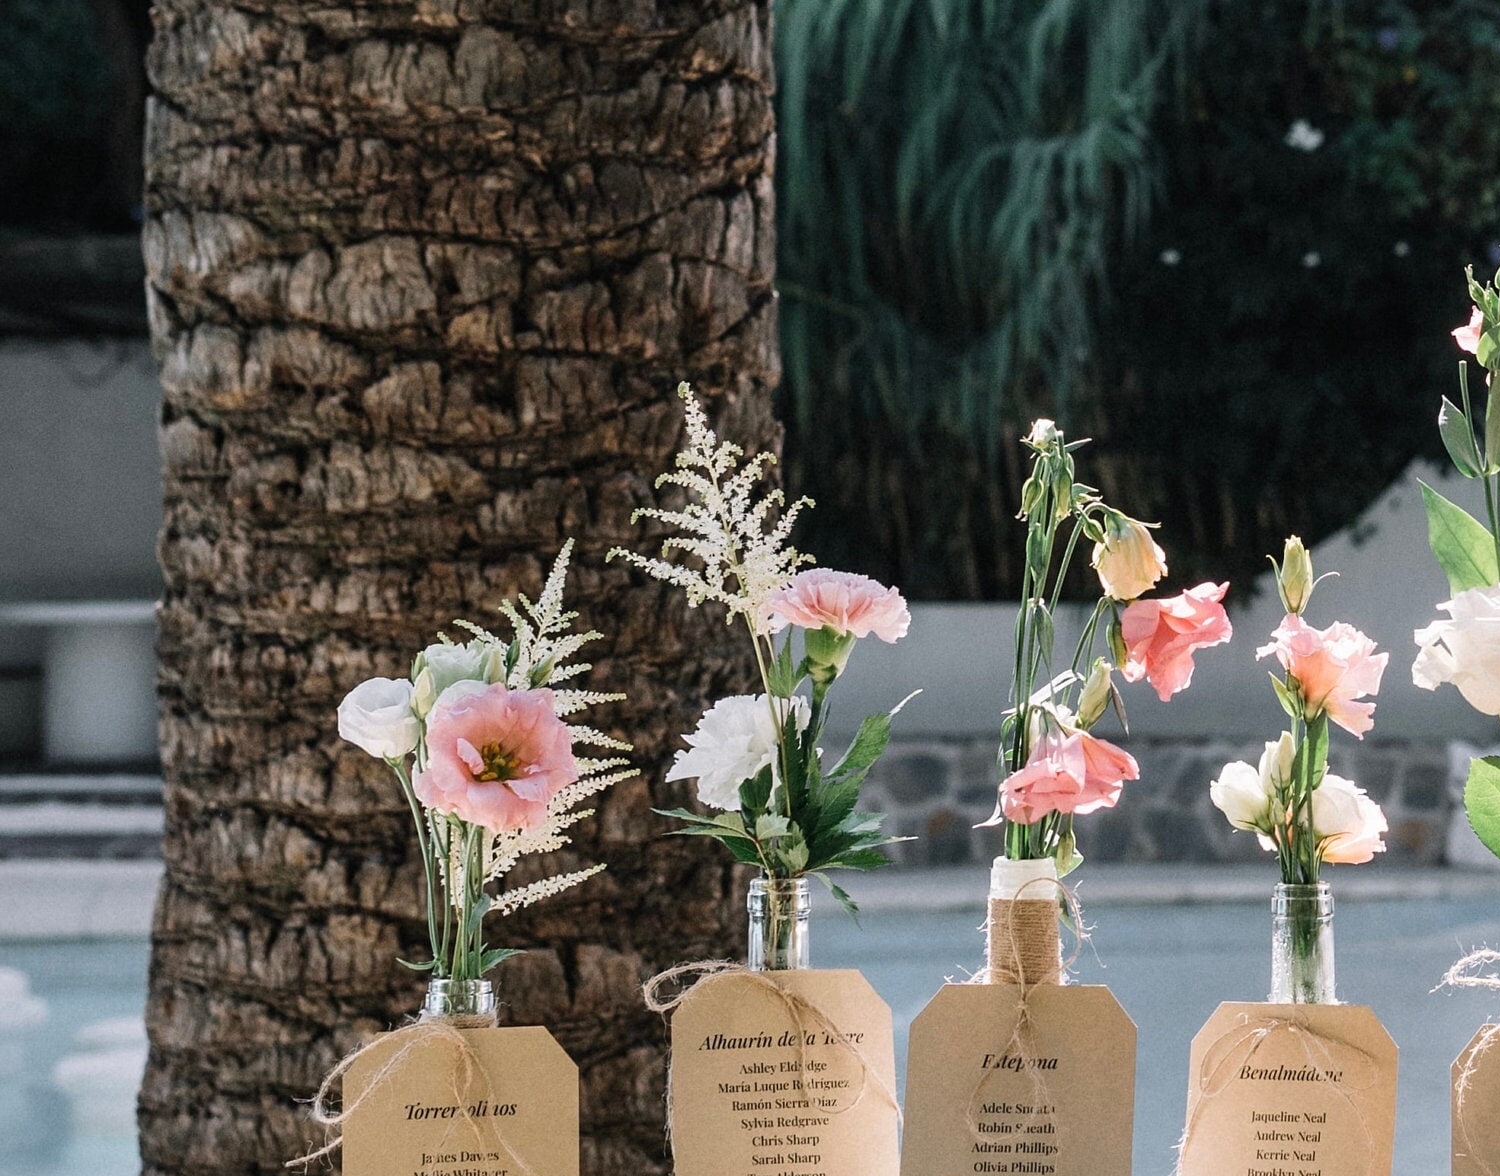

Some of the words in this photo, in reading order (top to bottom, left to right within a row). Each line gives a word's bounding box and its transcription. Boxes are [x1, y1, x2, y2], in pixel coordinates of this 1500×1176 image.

[698, 1032, 772, 1051] Alhaurín
[778, 1031, 796, 1046] de
[739, 1062, 776, 1075] Ashley
[719, 1082, 750, 1093] María
[754, 1081, 789, 1093] Luque
[732, 1100, 771, 1111] Ramón
[775, 1099, 809, 1109] Sierra
[980, 1102, 1012, 1114] Adele
[1251, 1111, 1300, 1123] Jaqueline
[1303, 1112, 1326, 1123] Neal
[741, 1117, 774, 1131] Sylvia
[777, 1116, 829, 1128] Redgrave
[978, 1122, 1012, 1132] Robin
[752, 1136, 783, 1146] Chris
[786, 1135, 819, 1146] Sharp
[1254, 1130, 1294, 1142] Andrew
[1299, 1131, 1320, 1142] Neal
[972, 1142, 1011, 1153] Adrian
[1015, 1142, 1058, 1156] Phillips
[1256, 1149, 1289, 1161] Kerrie
[1293, 1151, 1315, 1161] Neal
[752, 1154, 784, 1165] Sarah
[787, 1153, 820, 1164] Sharp
[974, 1162, 1007, 1173] Olivia
[1011, 1162, 1055, 1175] Phillips
